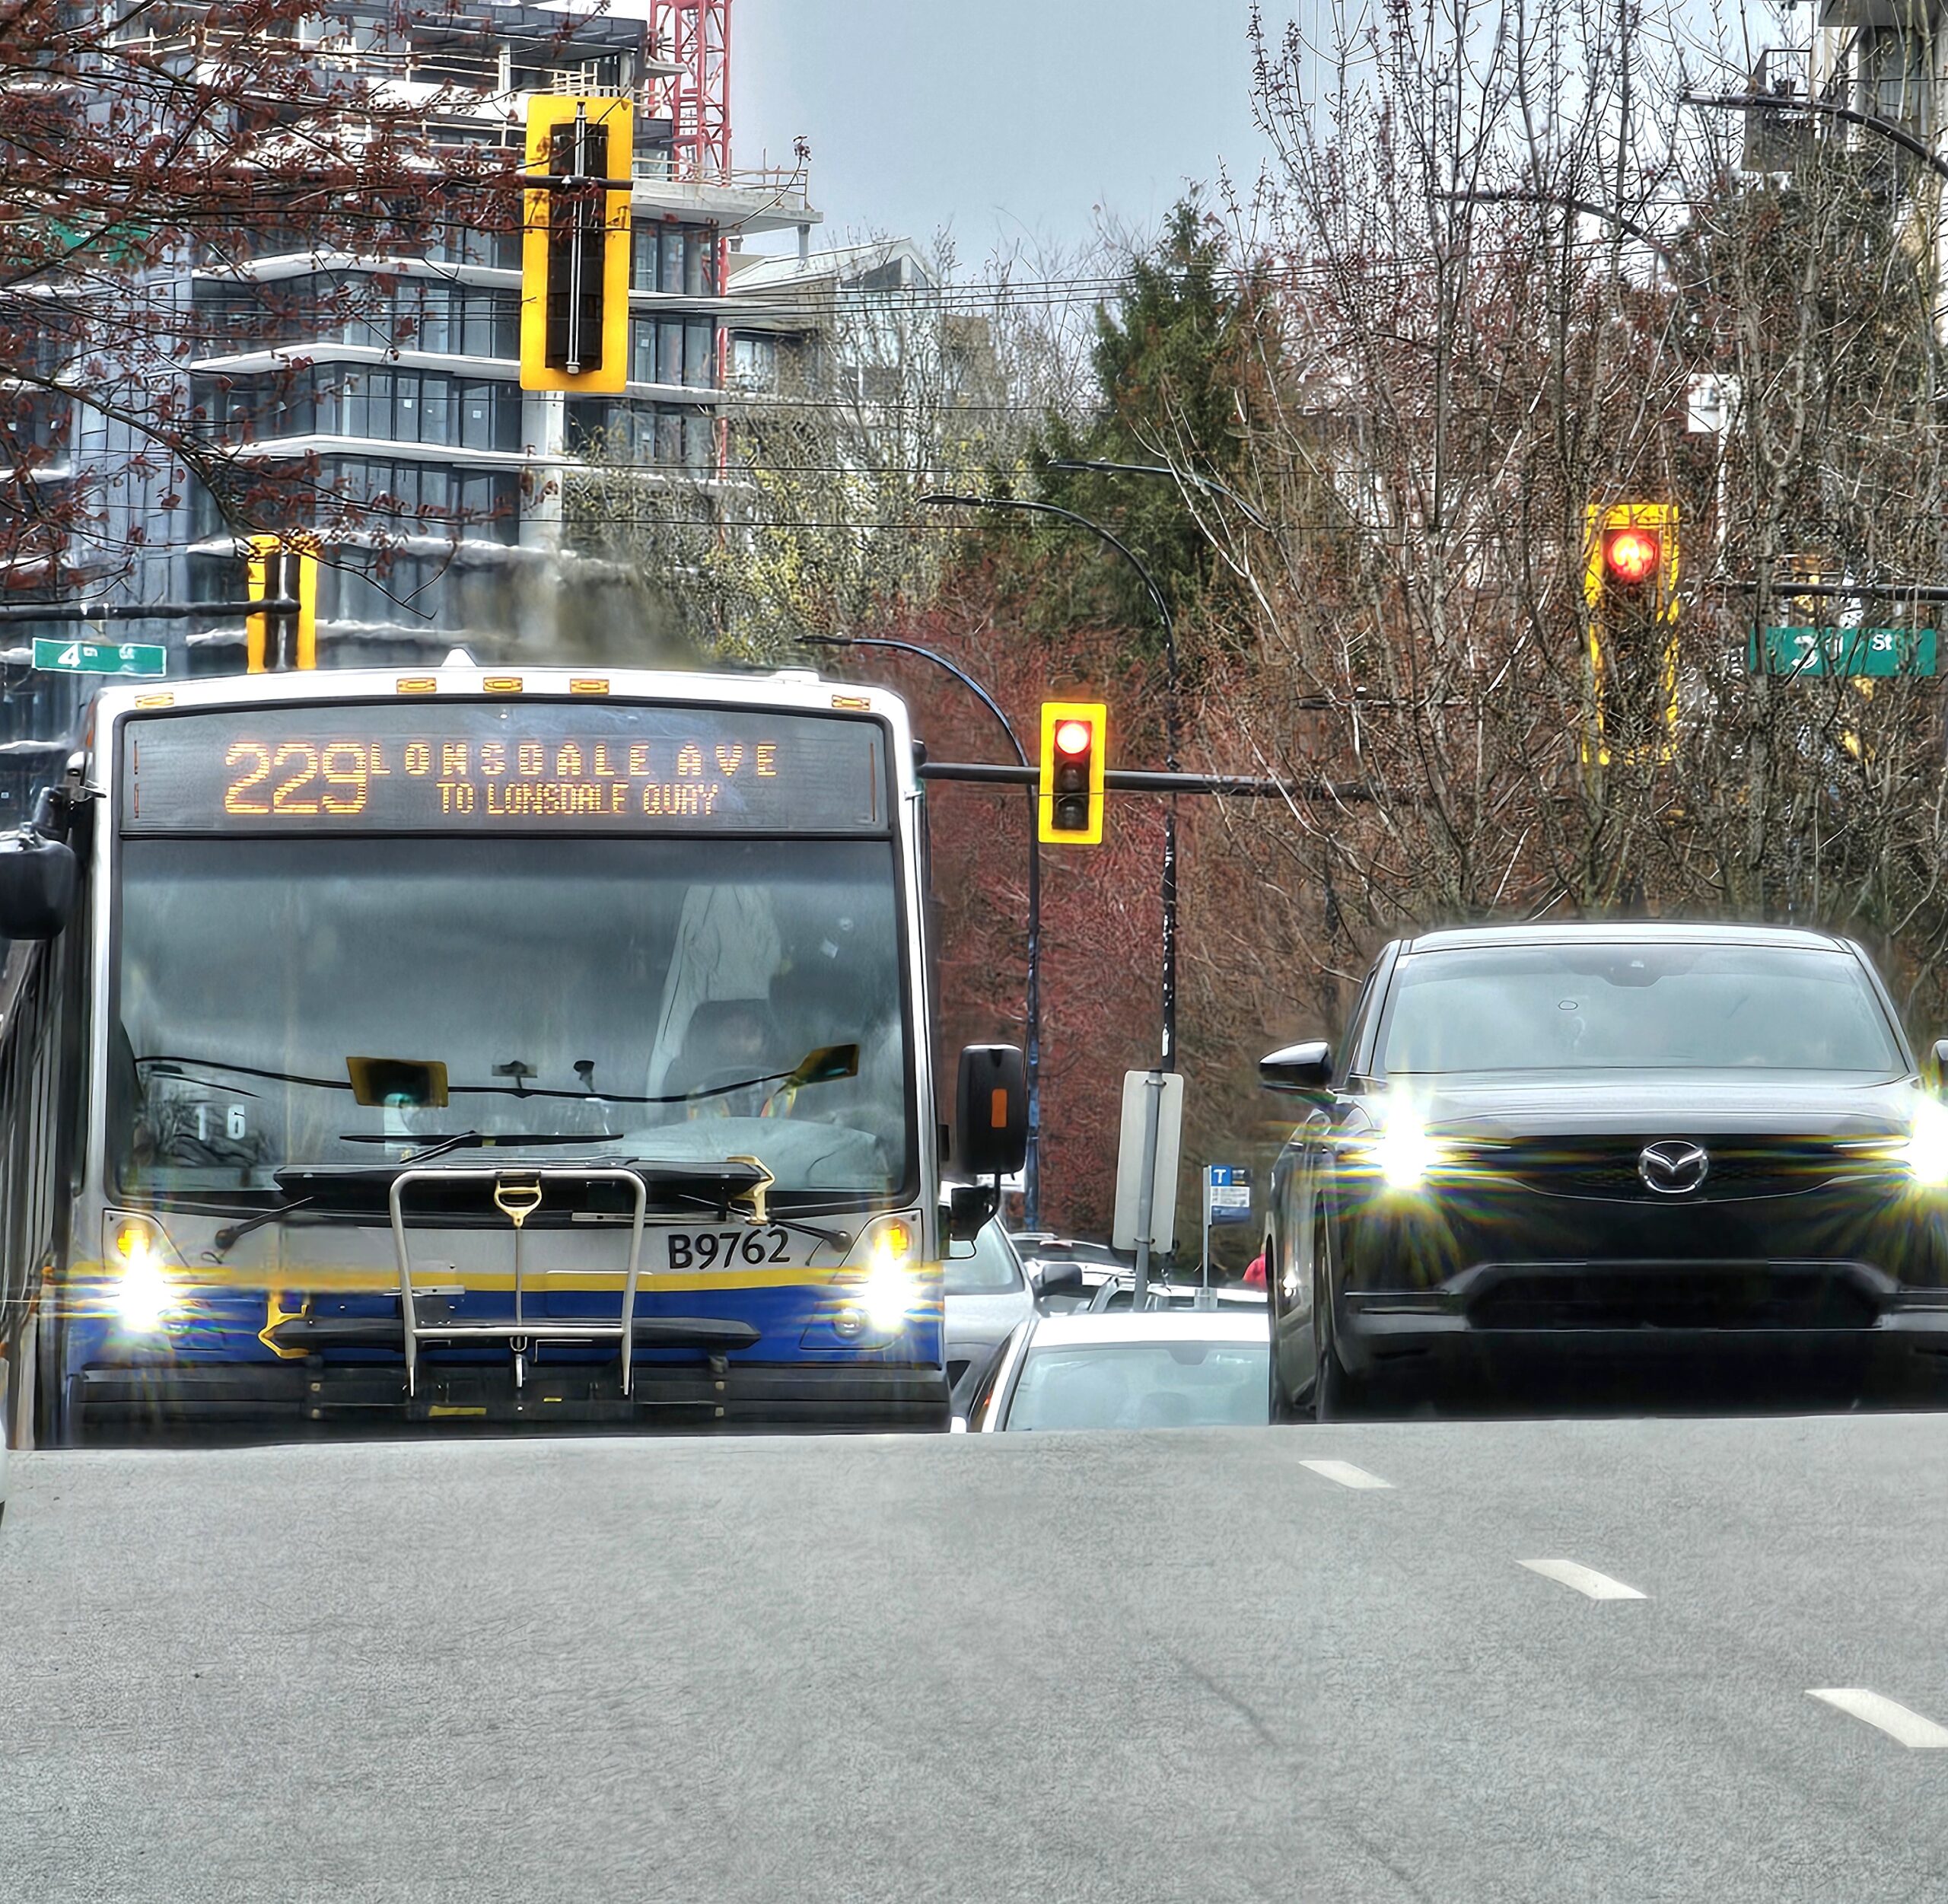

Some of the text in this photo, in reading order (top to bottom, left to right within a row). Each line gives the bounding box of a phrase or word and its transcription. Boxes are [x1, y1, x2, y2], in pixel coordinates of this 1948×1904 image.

[1872, 634, 1892, 651] St
[371, 743, 777, 776] LONSDALE AVE
[225, 741, 367, 813] 229
[436, 782, 718, 814] TO LONSDALE QUAY
[1213, 1169, 1227, 1184] T
[668, 1229, 791, 1269] B9762
